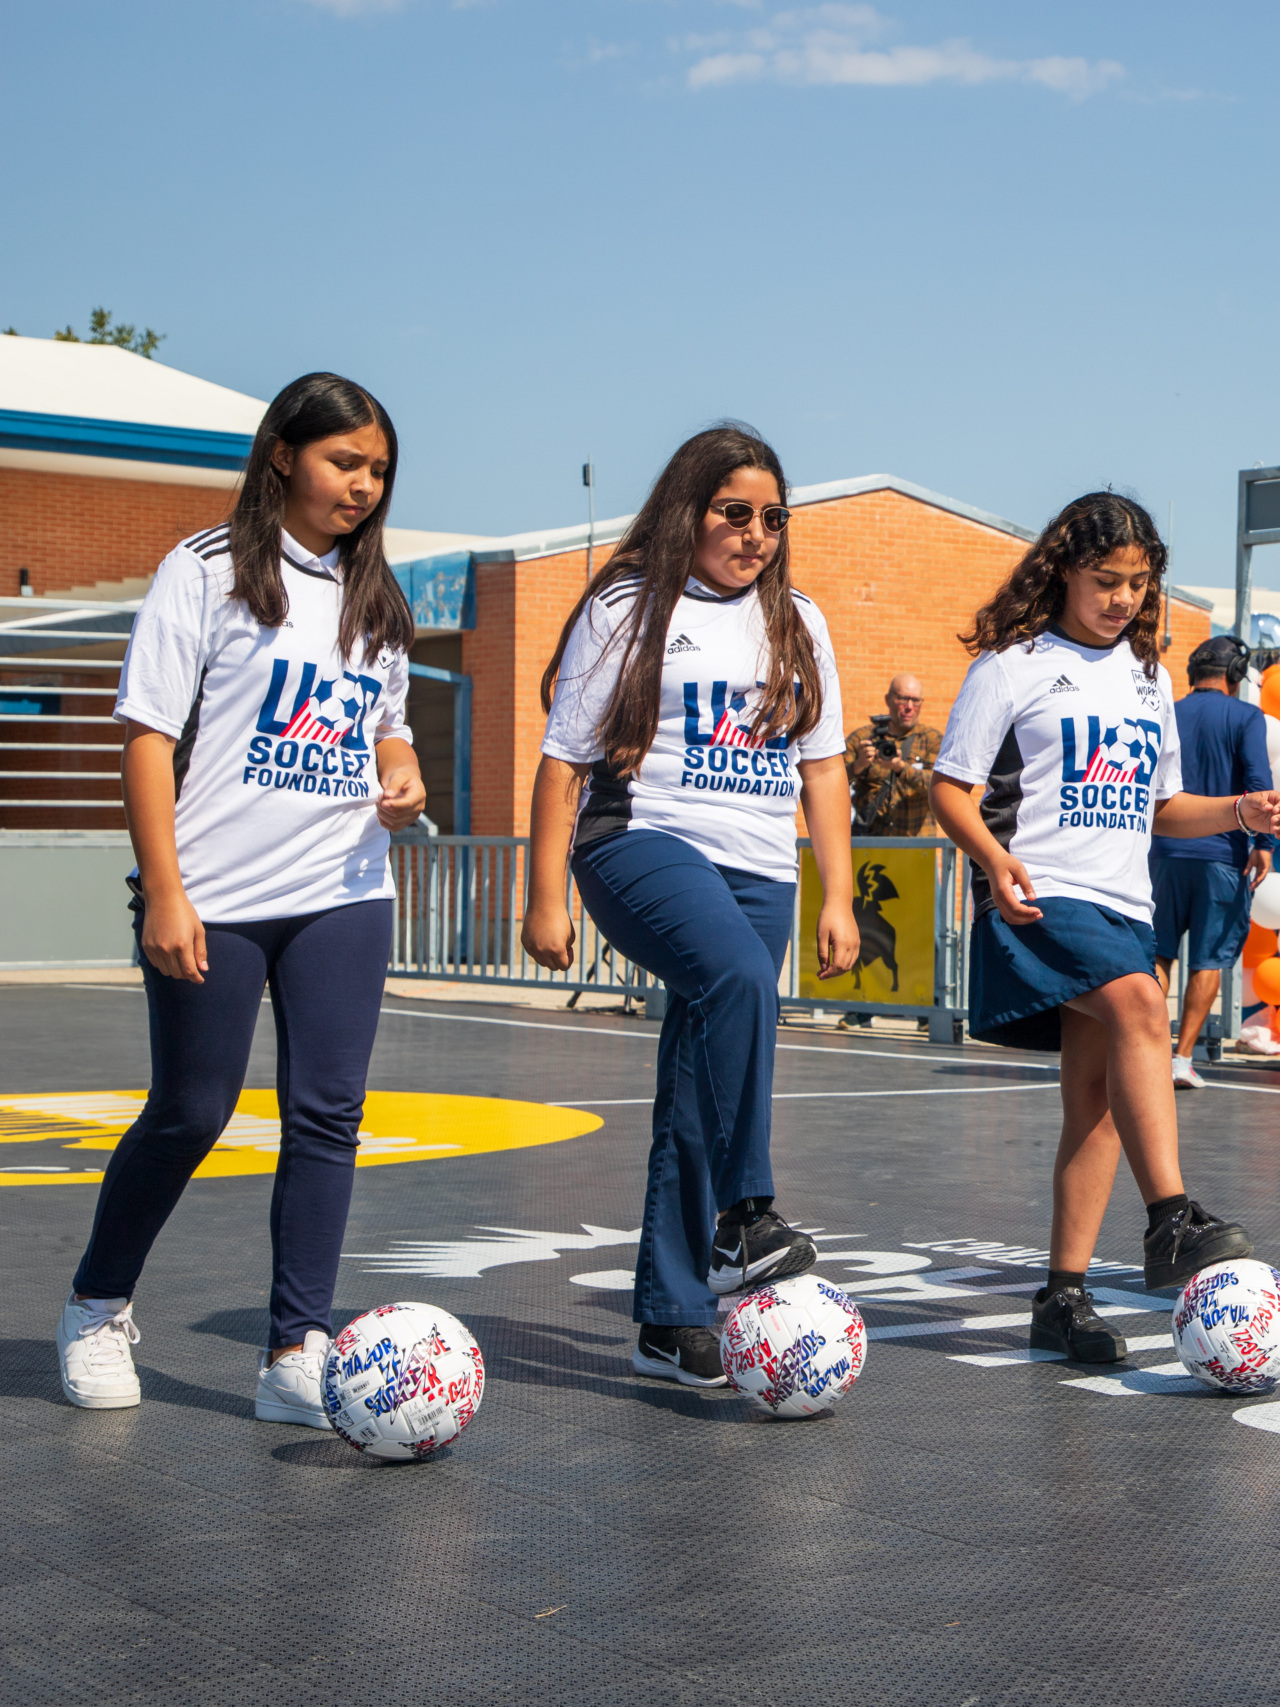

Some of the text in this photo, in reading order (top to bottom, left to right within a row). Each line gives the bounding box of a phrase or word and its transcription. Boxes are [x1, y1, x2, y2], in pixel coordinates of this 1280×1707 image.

[667, 645, 701, 654] adidas
[1049, 685, 1080, 694] adidas
[247, 736, 370, 778] SOCCER
[683, 746, 793, 778] SOCCER
[243, 766, 369, 798] FOUNDATION
[681, 770, 795, 797] FOUNDATION
[1060, 784, 1149, 815] SOCCER
[1058, 811, 1147, 834] FOUNDATON
[1200, 1304, 1249, 1330] MAJOR
[343, 1338, 398, 1381] MAJOR
[804, 1357, 850, 1398] MAJOR
